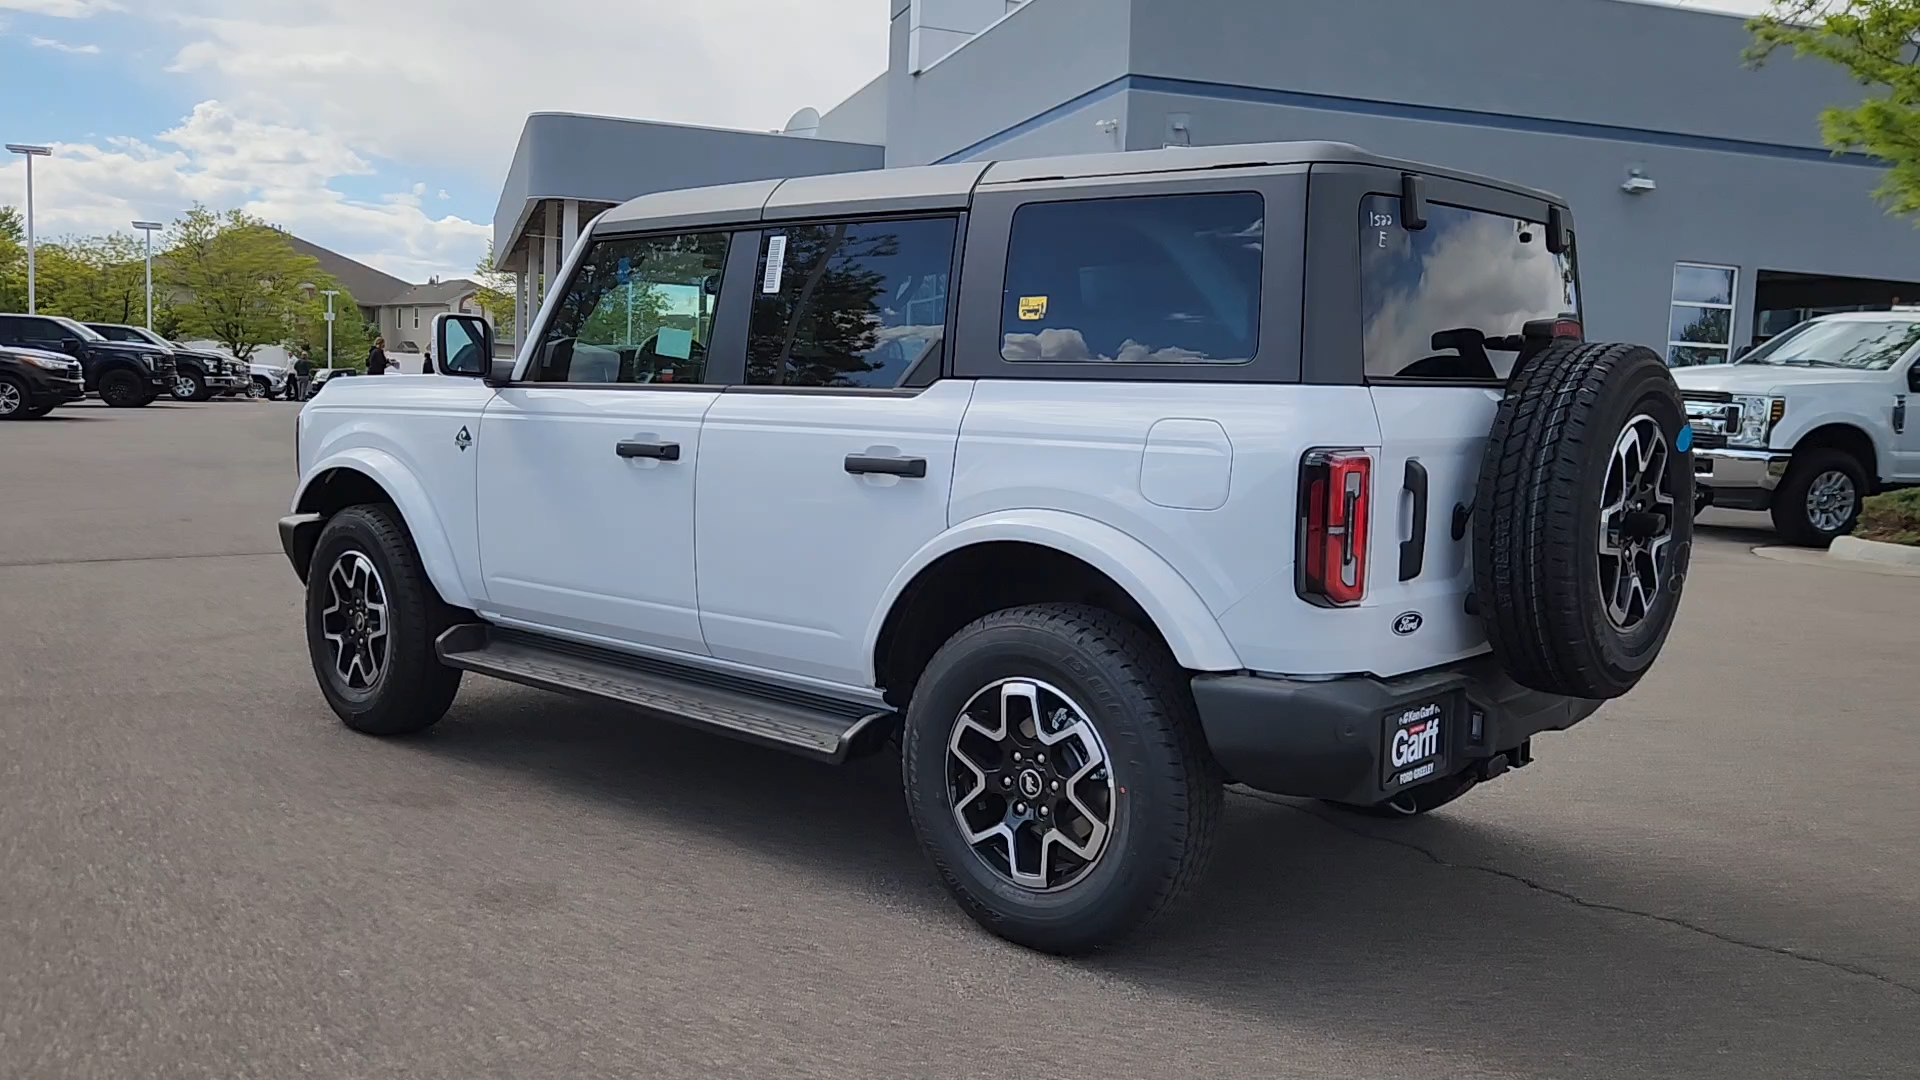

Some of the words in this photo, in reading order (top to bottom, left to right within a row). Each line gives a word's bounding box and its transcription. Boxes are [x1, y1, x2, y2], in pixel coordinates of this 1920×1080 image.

[1378, 230, 1388, 248] E
[1398, 615, 1420, 632] Ford
[1391, 718, 1440, 768] Garff
[1399, 770, 1413, 785] FORD
